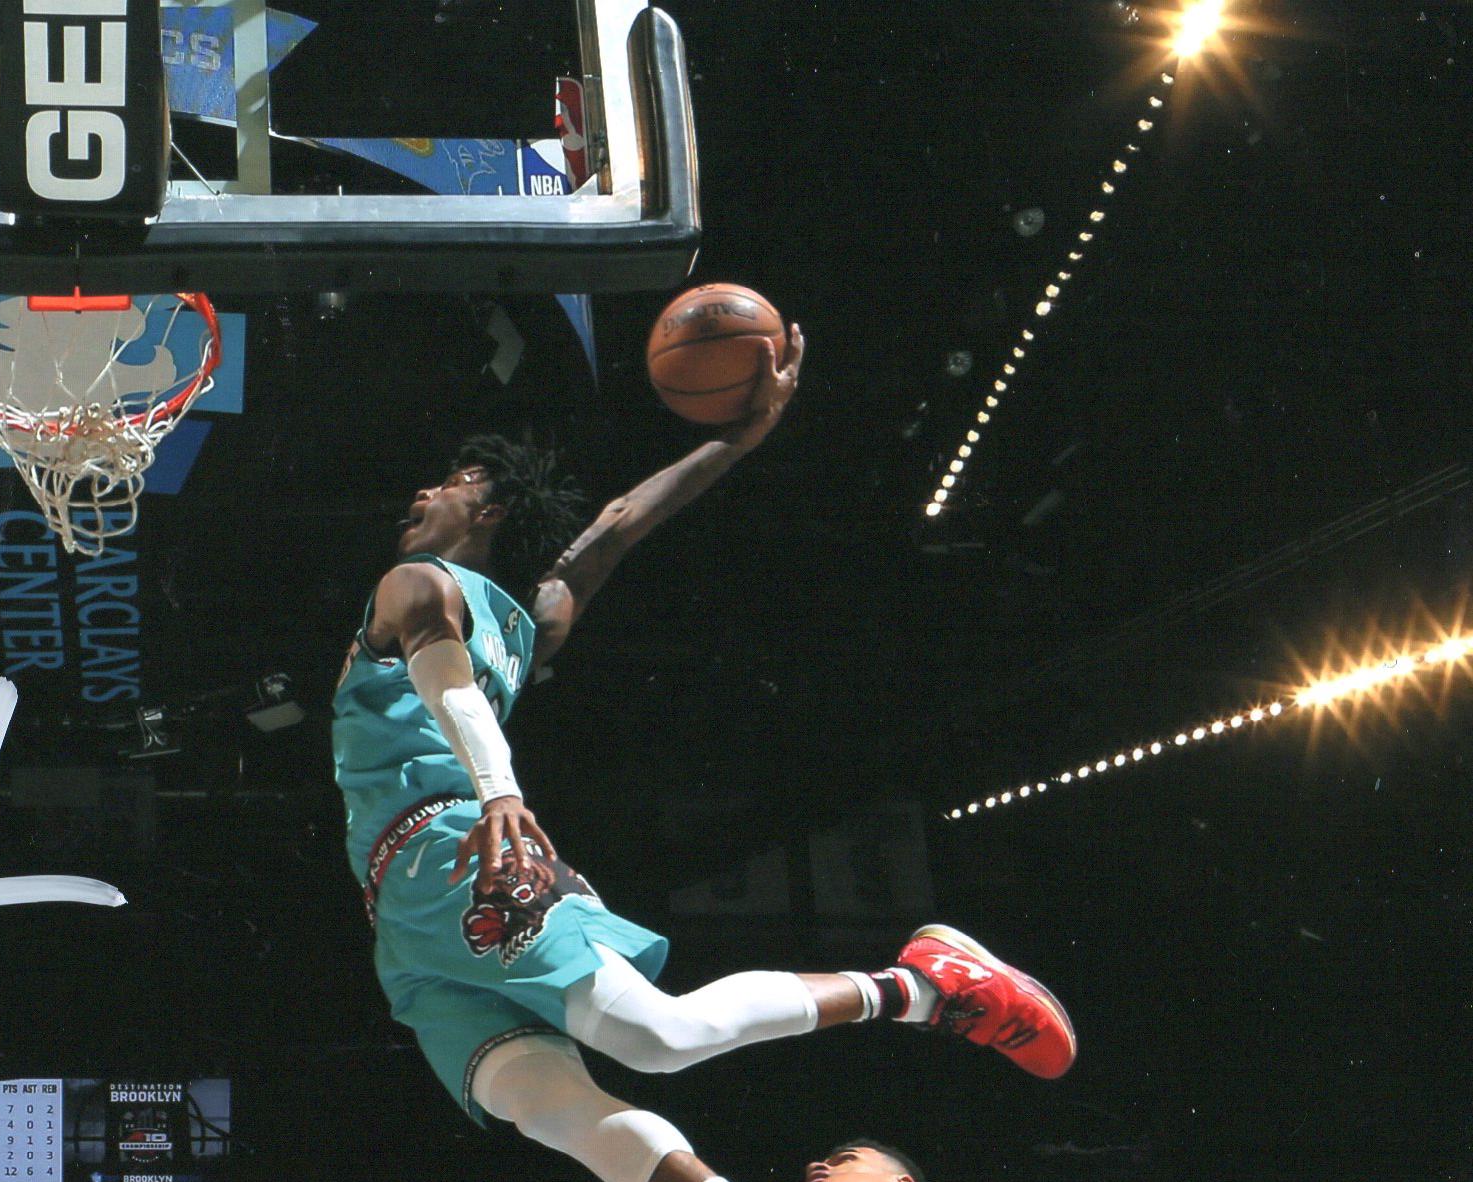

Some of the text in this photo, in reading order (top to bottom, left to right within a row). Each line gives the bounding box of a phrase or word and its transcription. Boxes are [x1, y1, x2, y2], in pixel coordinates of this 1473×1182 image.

[530, 175, 564, 196] NBA
[72, 511, 143, 703] BARCLAYS
[3, 1085, 18, 1094] PTS
[23, 1085, 37, 1094] AST
[110, 1091, 181, 1102] BROOKLYN
[123, 1175, 173, 1182] BROOKLYN
